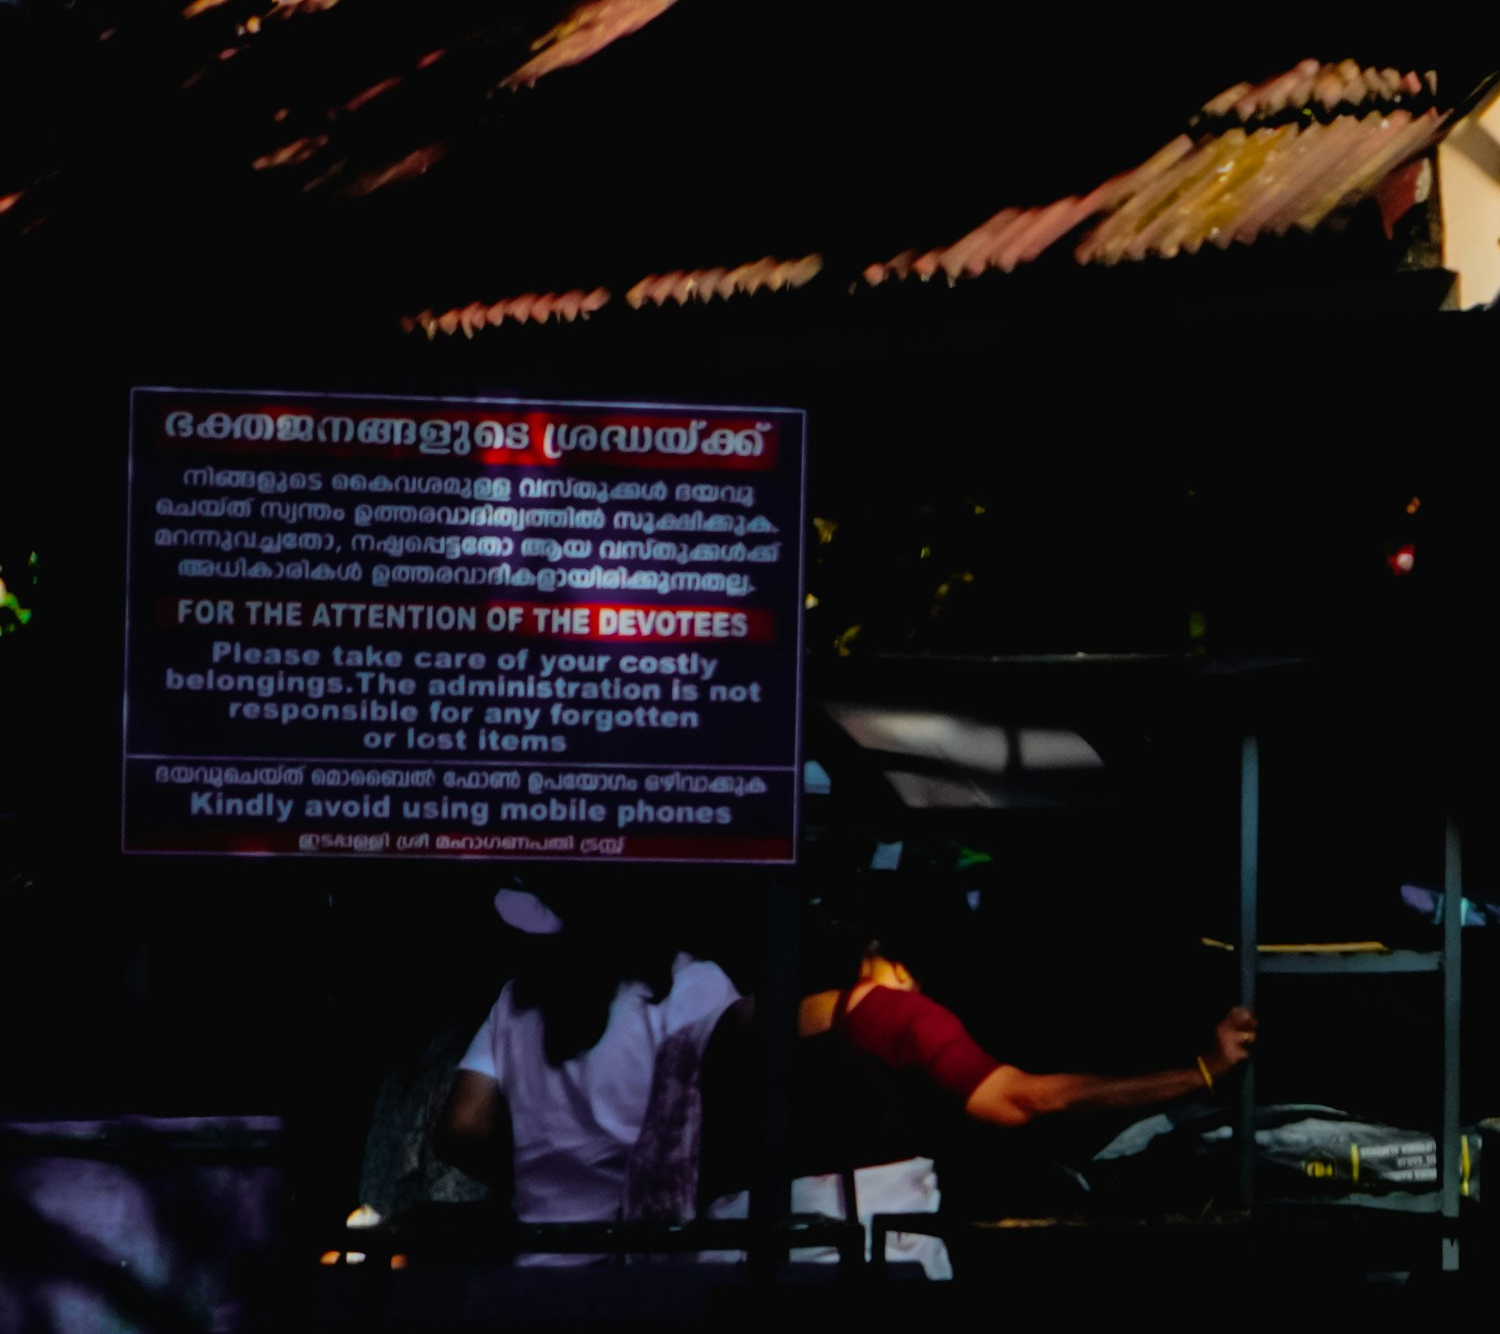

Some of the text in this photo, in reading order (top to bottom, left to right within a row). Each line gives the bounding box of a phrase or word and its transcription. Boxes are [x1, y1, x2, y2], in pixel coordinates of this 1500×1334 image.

[166, 412, 771, 458] ഭക്തജനങ്ങളുടെ ശ്രദ്ധയ്ക്ക്
[184, 467, 755, 507] നിങ്ങളുടെ കൈവശമുള്ള വസ്തുക്കൾ ദയവു
[178, 600, 746, 637] FOR THE ATTENTION OF THE DEVOTEES
[213, 642, 716, 679] Please take care of your costly
[429, 675, 660, 700] administration
[672, 679, 697, 701] is
[710, 683, 760, 702] not
[230, 700, 698, 732] responsible for any forgotten
[364, 728, 566, 751] or lost items
[192, 792, 731, 827] Kindly avoid using mobile phones
